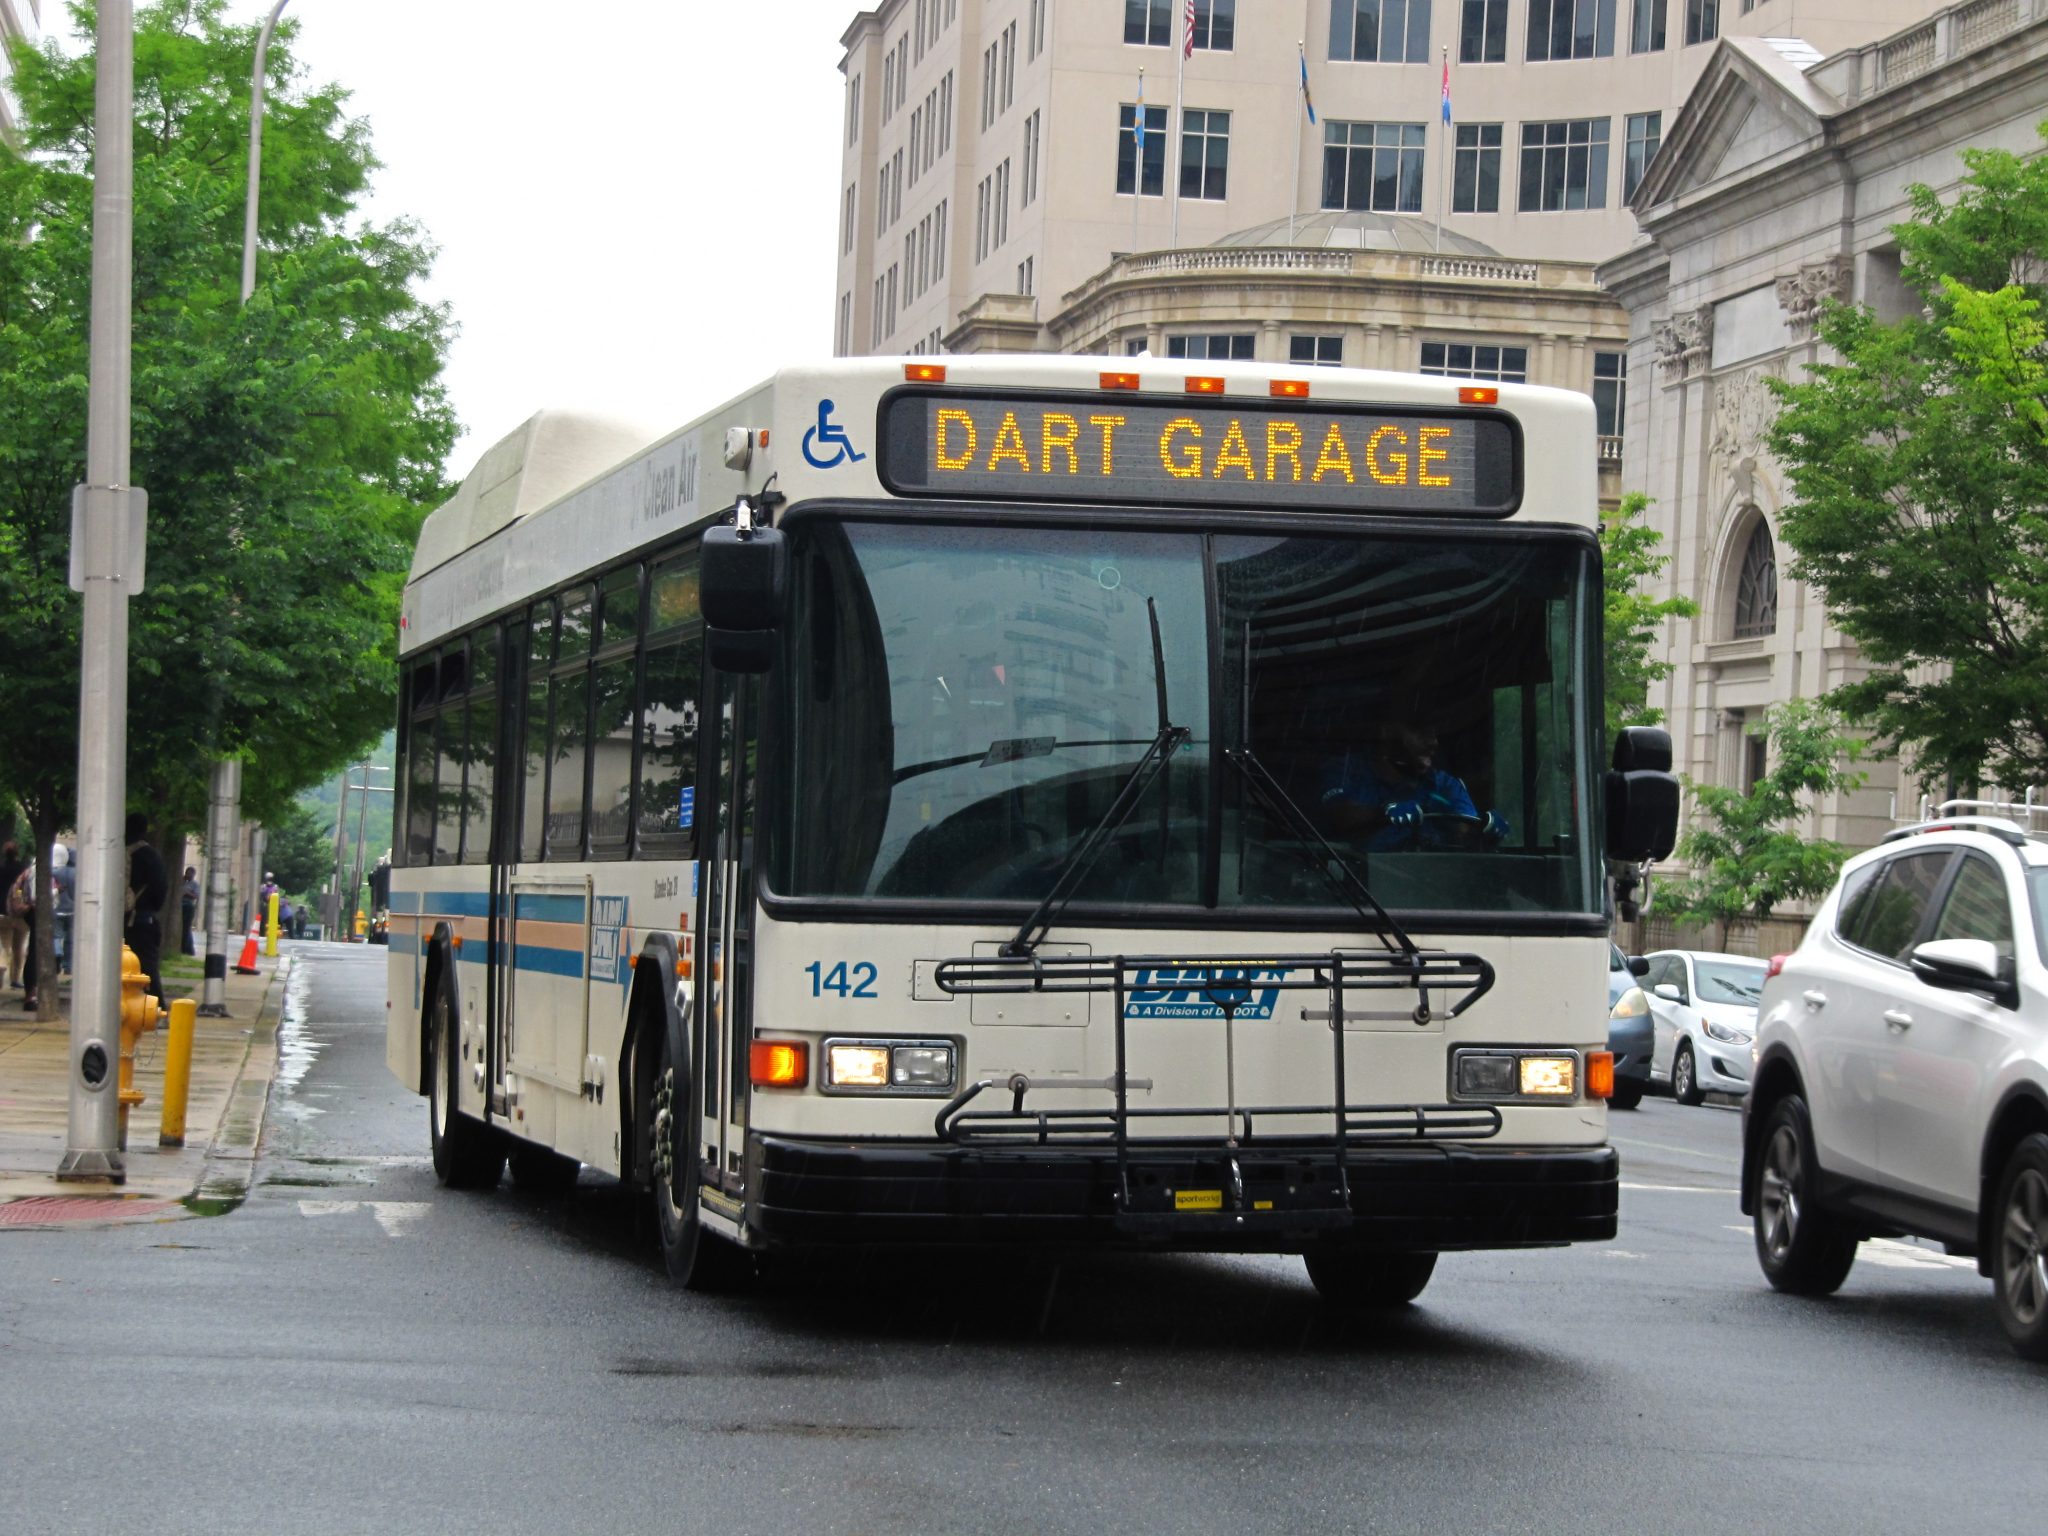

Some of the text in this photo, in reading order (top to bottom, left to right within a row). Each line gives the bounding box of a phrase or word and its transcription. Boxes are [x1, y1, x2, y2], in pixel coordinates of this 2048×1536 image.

[677, 439, 698, 506] Air
[935, 409, 1453, 487] DART GARAGE
[804, 960, 879, 998] 142
[1142, 1005, 1258, 1016] A Division of DDOT
